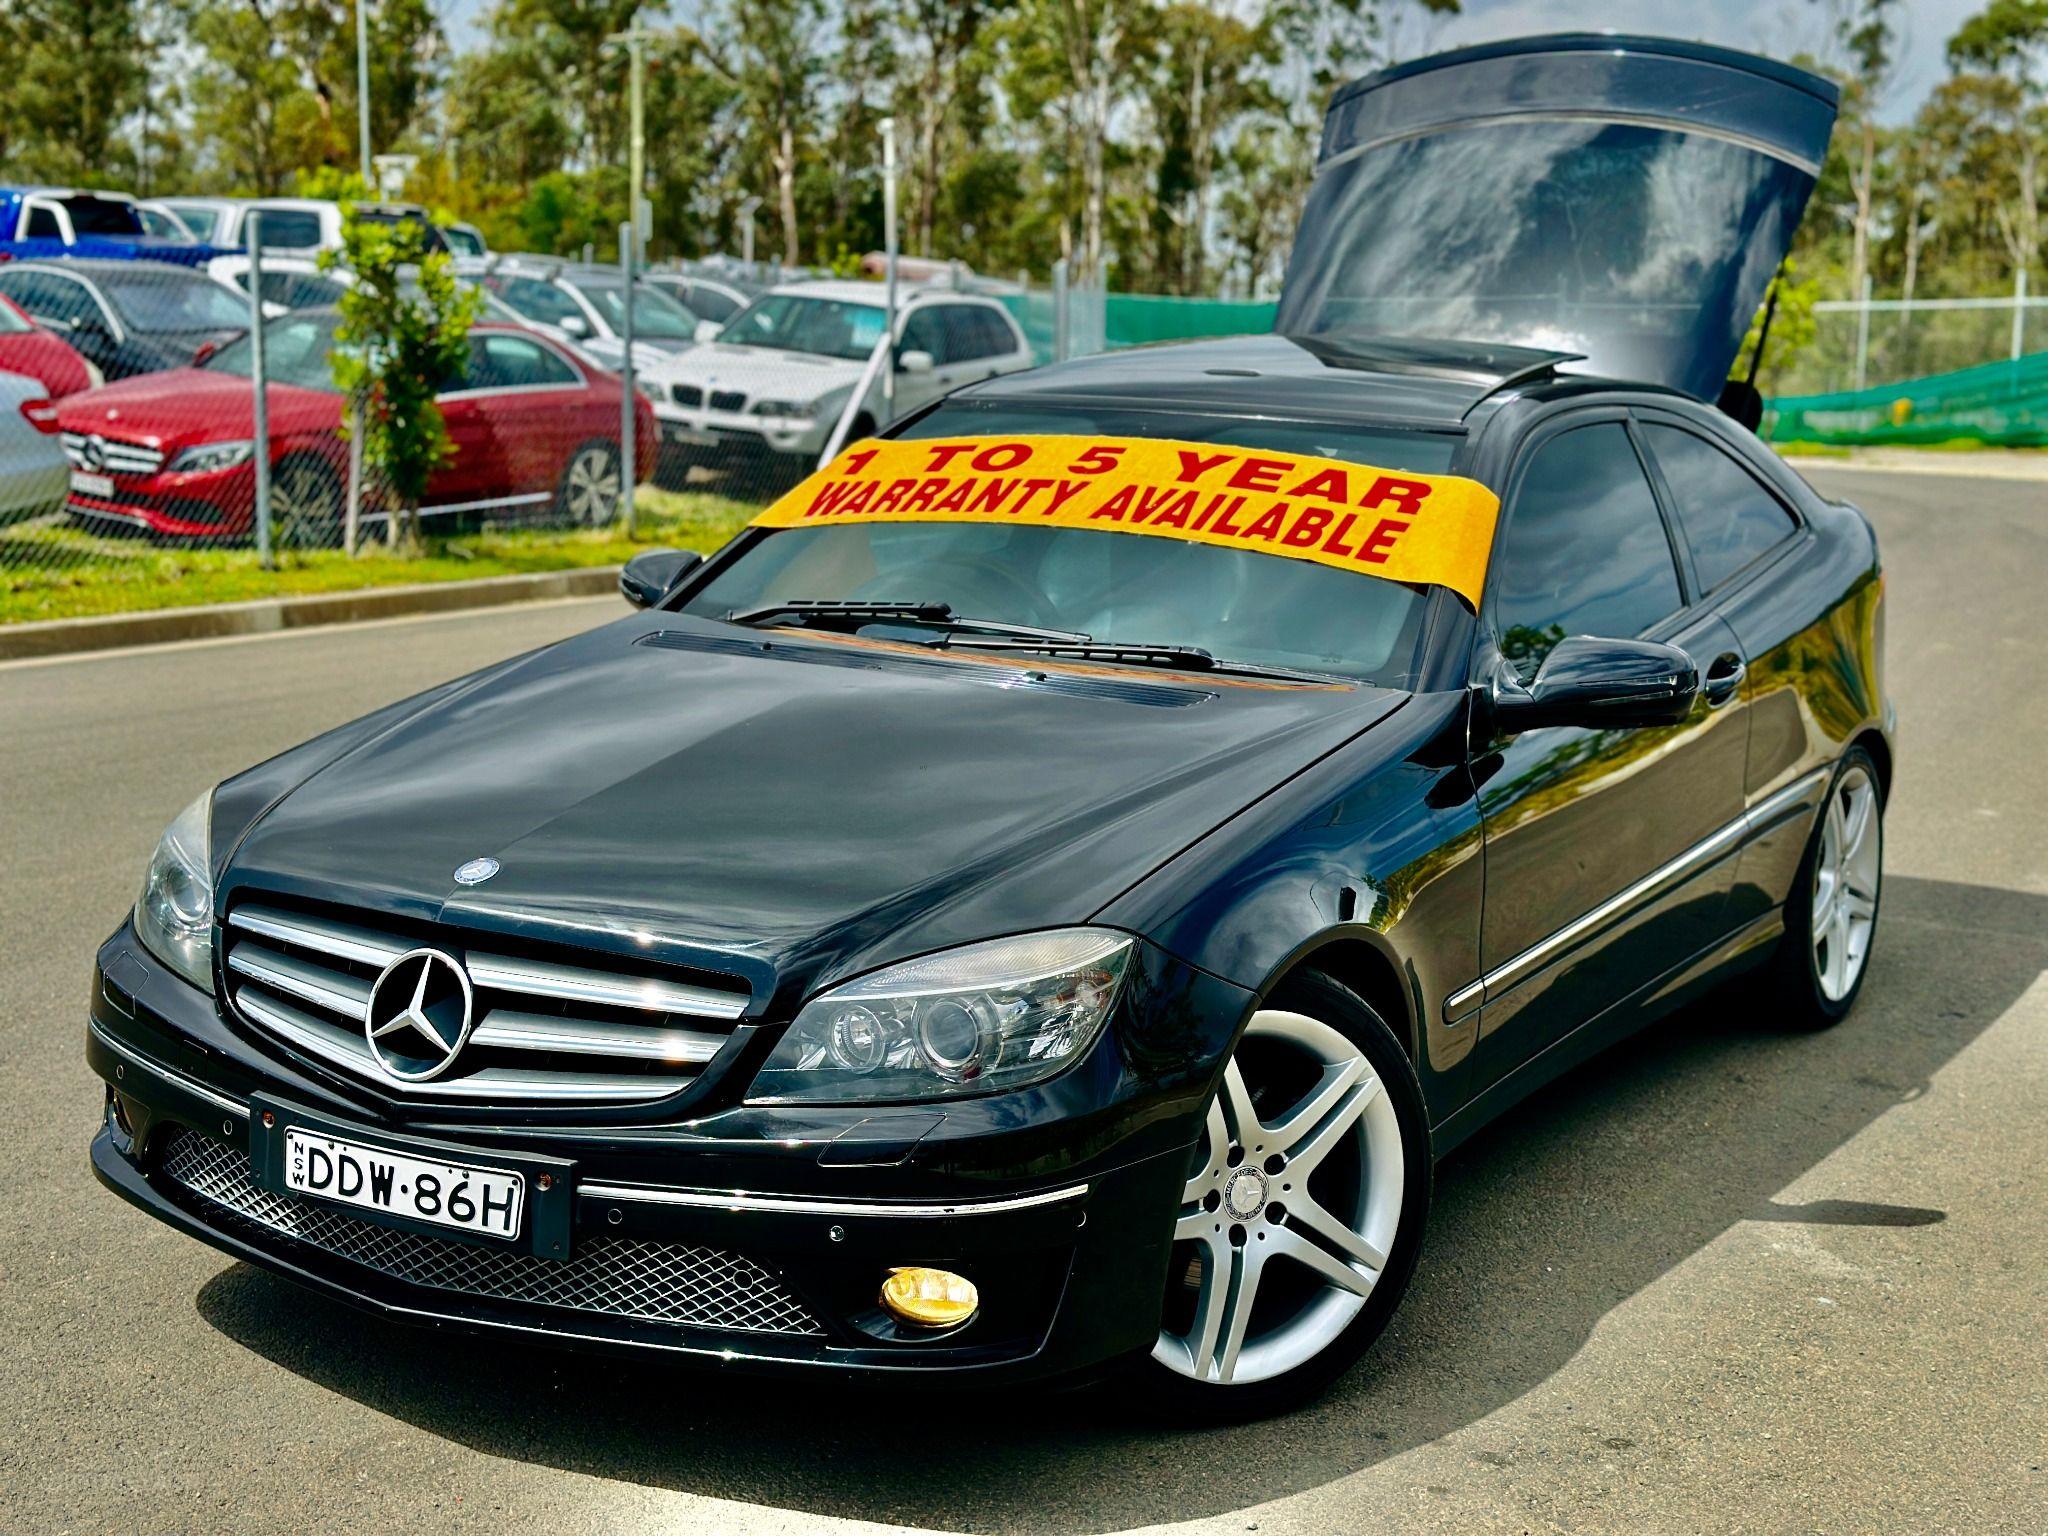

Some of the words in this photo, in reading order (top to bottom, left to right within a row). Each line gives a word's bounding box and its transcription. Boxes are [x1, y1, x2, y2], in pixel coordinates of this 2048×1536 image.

[844, 449, 879, 475] 1
[925, 443, 1034, 473] TO
[1067, 446, 1127, 475] 5
[1176, 450, 1433, 515] YEAR
[805, 478, 1091, 517] WARRANTY
[1088, 484, 1410, 564] AVAILABLE
[292, 1141, 305, 1186] NSW
